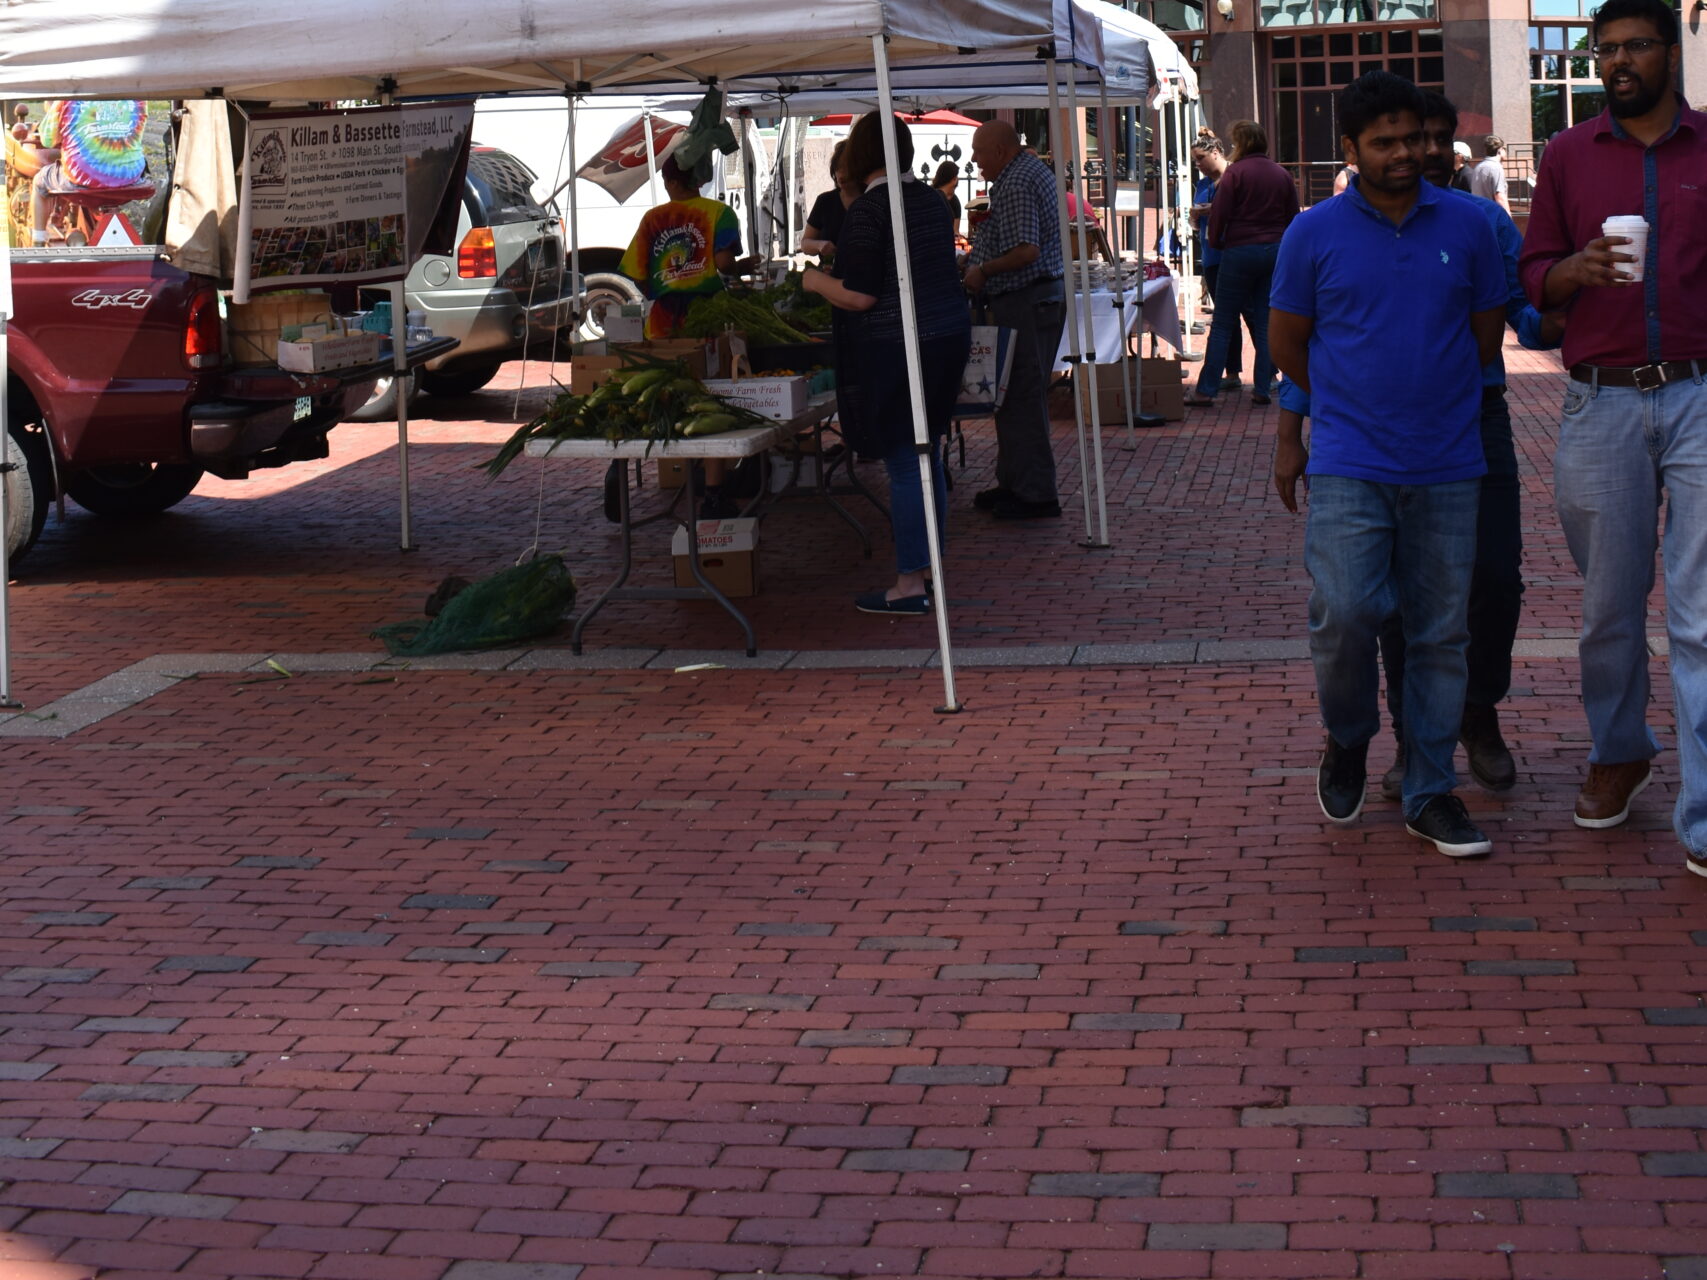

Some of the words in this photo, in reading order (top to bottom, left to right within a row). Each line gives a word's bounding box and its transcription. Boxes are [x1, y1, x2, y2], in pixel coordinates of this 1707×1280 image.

[291, 126, 328, 148] Killam
[333, 124, 340, 144] &
[345, 122, 400, 143] Bassette
[402, 116, 439, 137] Farmstead,
[440, 115, 453, 133] LLC
[291, 152, 299, 162] 14
[301, 150, 318, 164] Tryon
[320, 149, 328, 160] St.
[339, 146, 355, 159] 1098
[357, 144, 372, 156] Main
[374, 144, 382, 156] St.
[316, 173, 335, 182] Produce
[340, 170, 353, 179] USDA
[354, 169, 366, 178] Pork
[372, 167, 390, 176] Chicken
[72, 289, 152, 309] 4x4
[735, 386, 757, 396] Farm
[759, 383, 782, 395] Fresh
